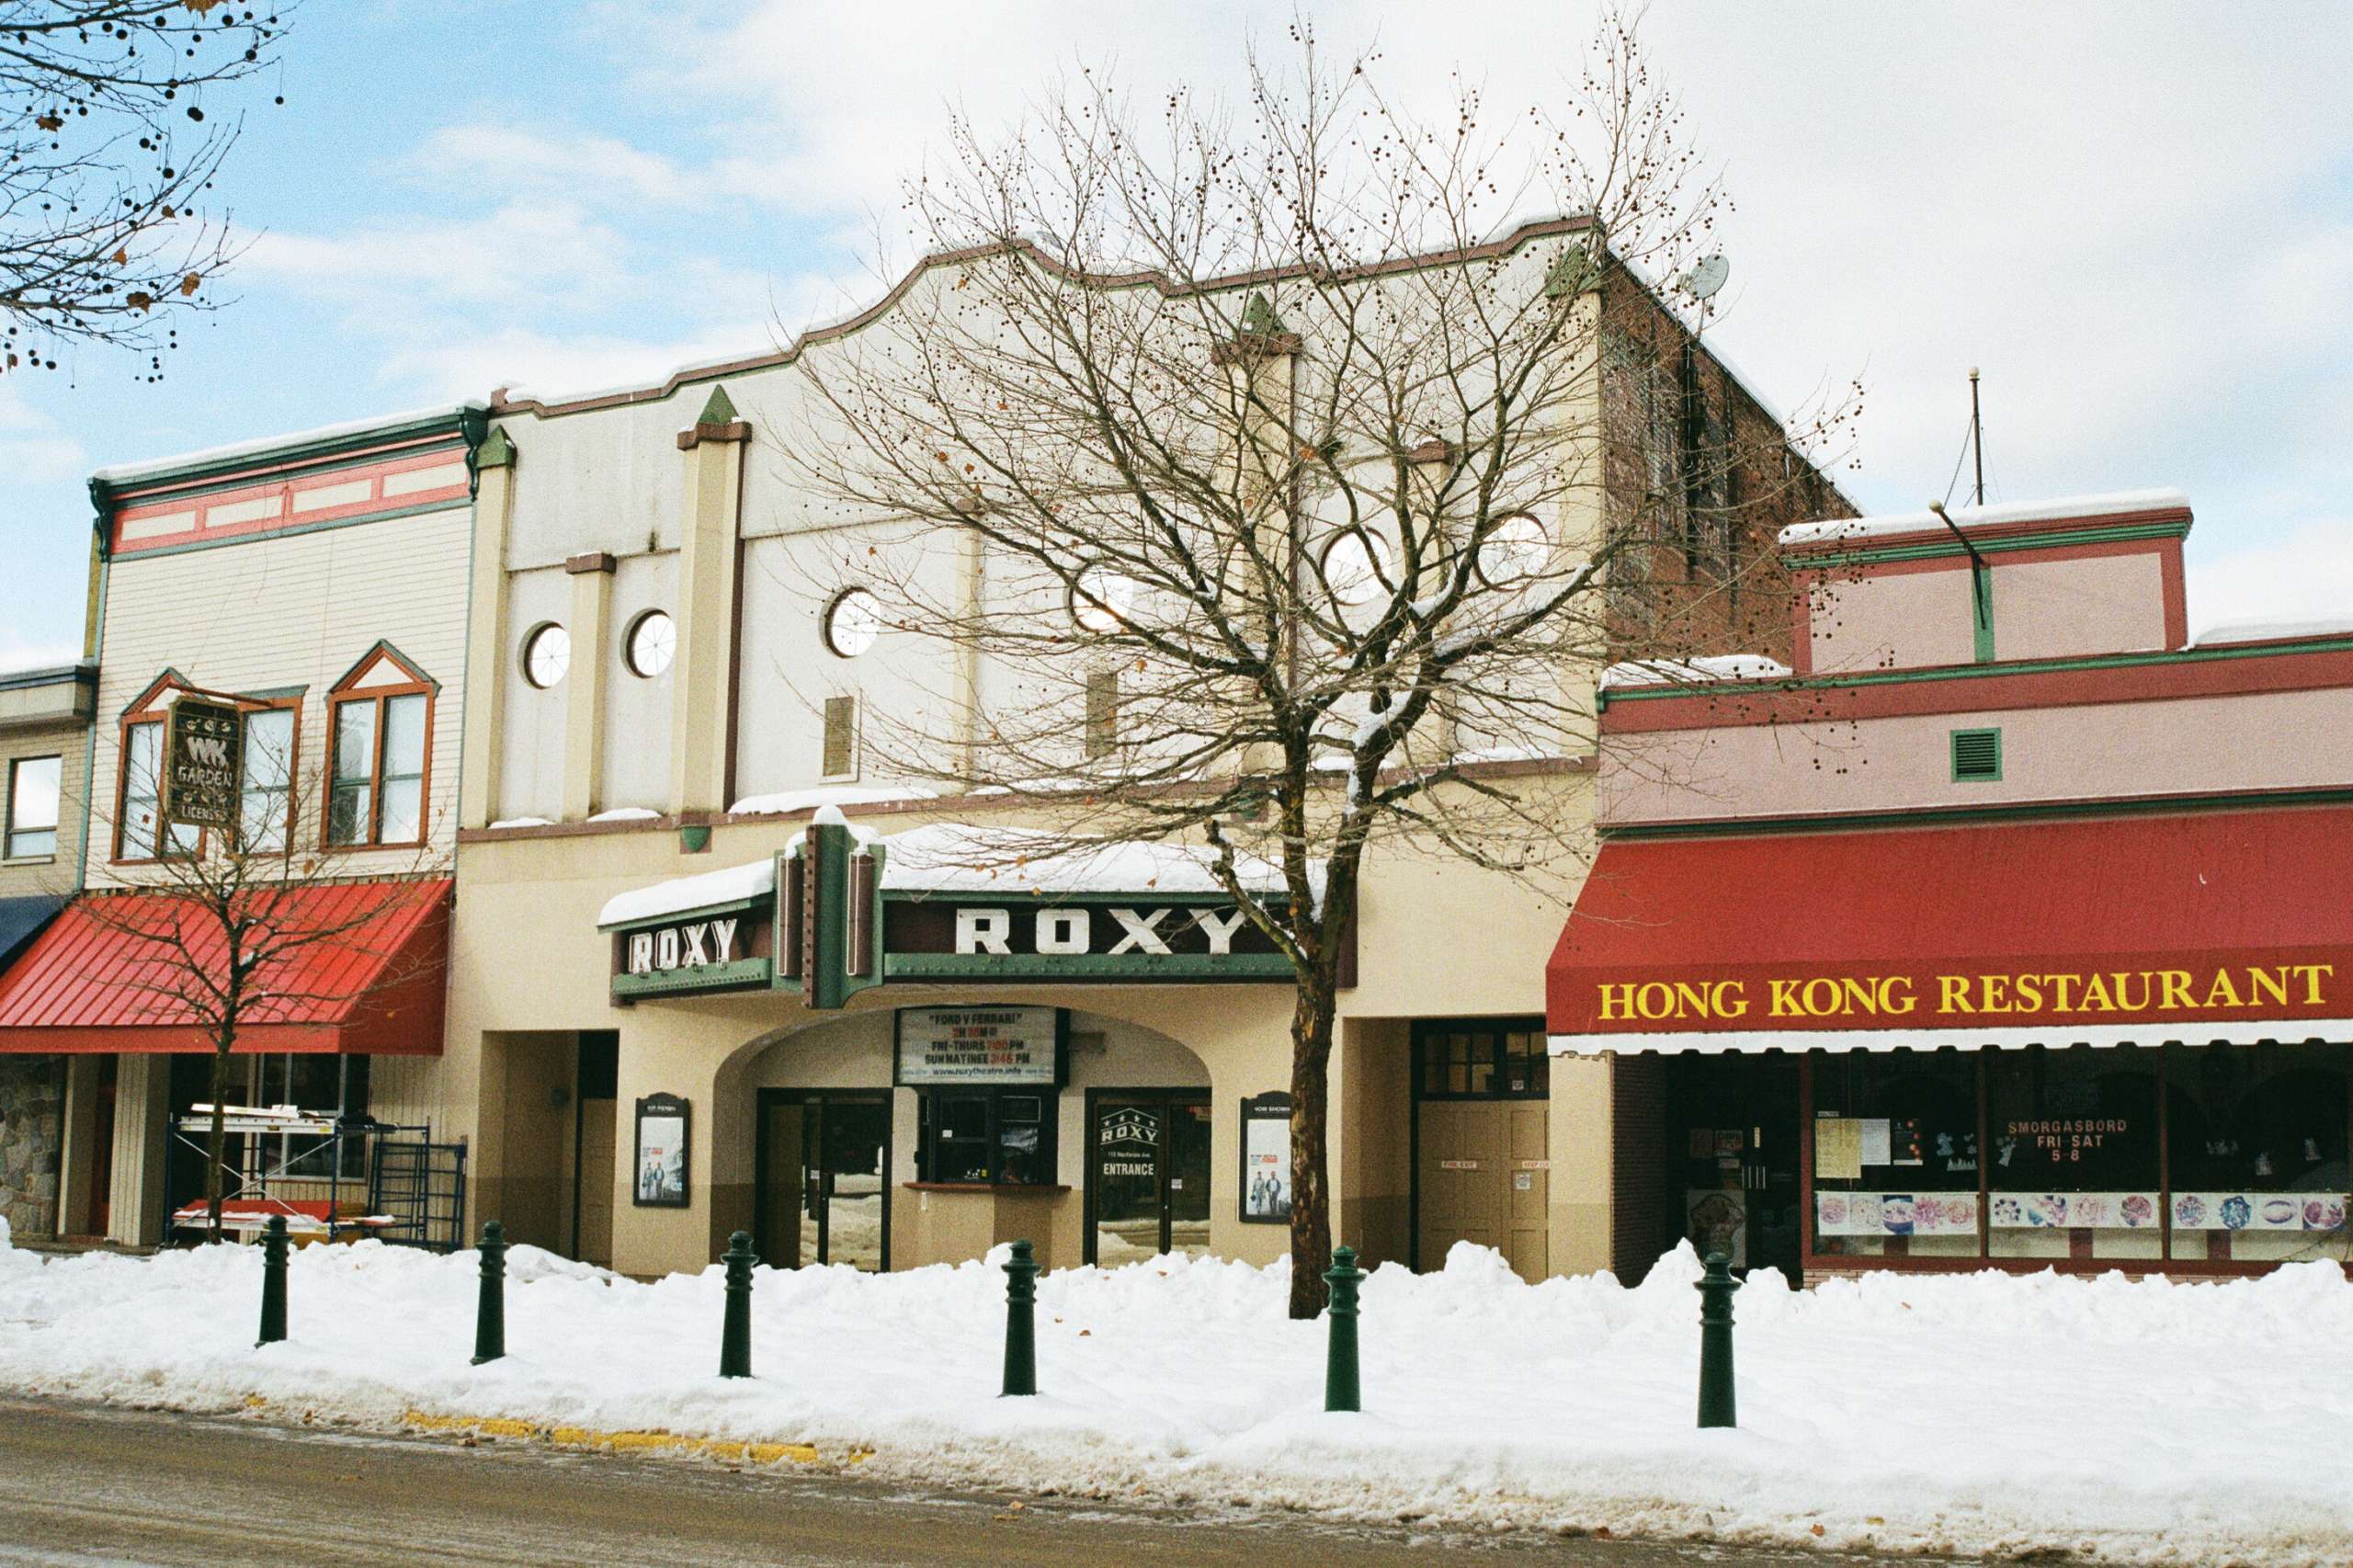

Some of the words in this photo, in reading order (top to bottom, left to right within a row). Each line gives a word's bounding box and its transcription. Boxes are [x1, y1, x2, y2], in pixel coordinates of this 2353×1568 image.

[178, 766, 233, 788] GARDEN
[956, 908, 1245, 955] ROXY
[629, 918, 737, 974] ROXY
[1597, 981, 1748, 1019] HONG
[1768, 976, 1917, 1017] KONG
[1937, 964, 2333, 1013] RESTAURANT
[925, 1053, 945, 1065] SUN
[946, 1053, 988, 1064] MATINEE
[1101, 1125, 1156, 1142] ROXY
[2008, 1119, 2127, 1134] SMORGASBORD
[1103, 1163, 1154, 1176] ENTRANCE
